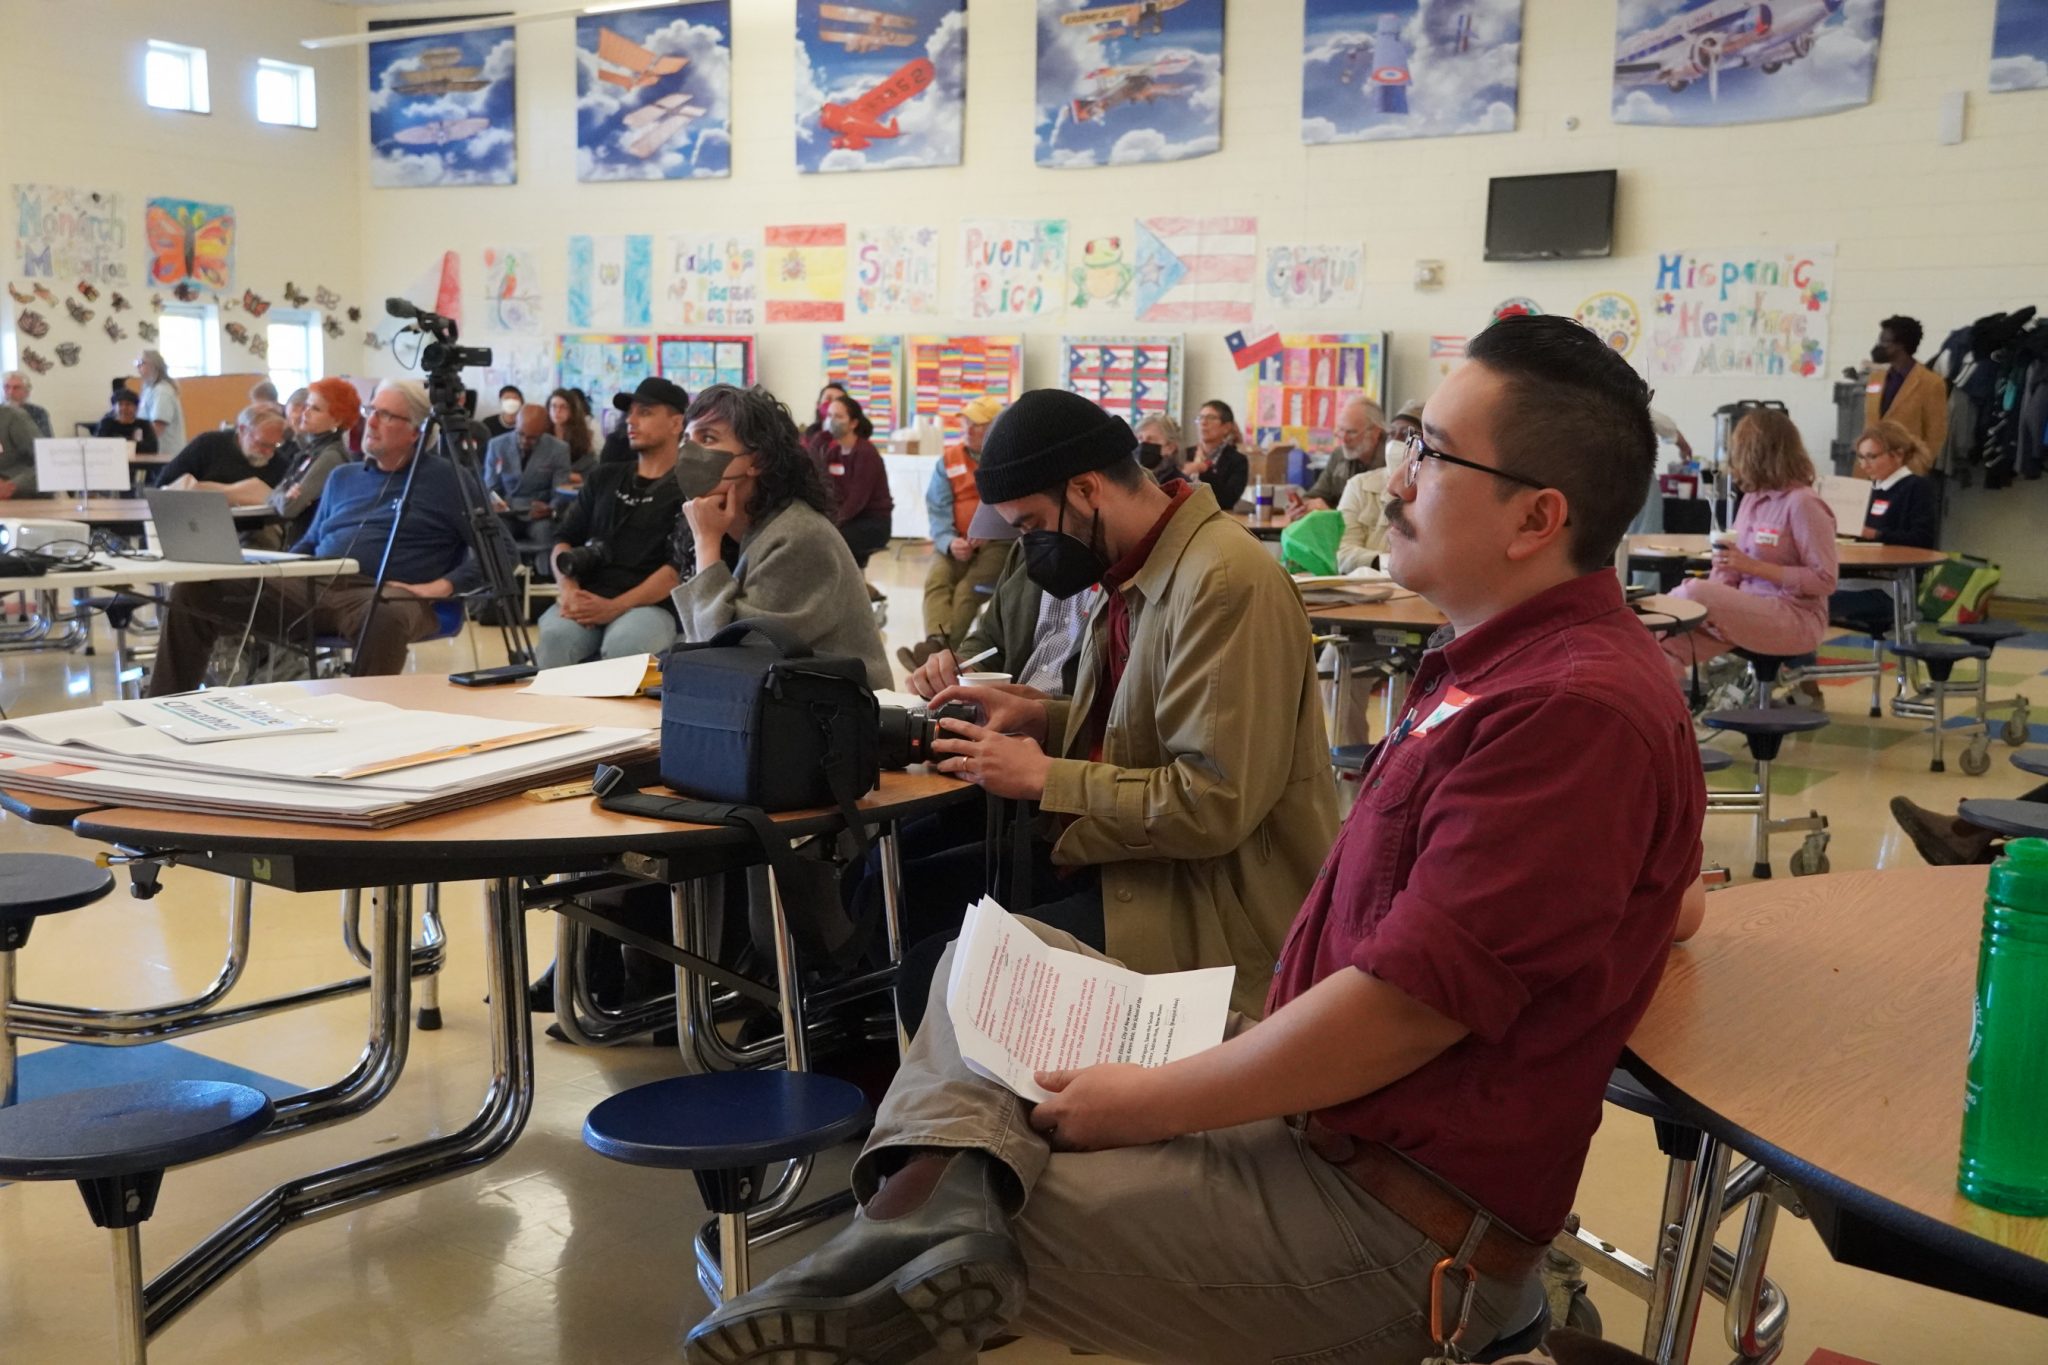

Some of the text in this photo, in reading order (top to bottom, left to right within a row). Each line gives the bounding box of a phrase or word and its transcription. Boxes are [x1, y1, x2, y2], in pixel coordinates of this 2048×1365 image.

[859, 245, 929, 289] Spain
[965, 226, 1062, 271] Puerto
[973, 273, 1043, 319] Rico
[1655, 254, 1814, 301] Hispanic
[163, 701, 241, 730] Climathon
[207, 697, 249, 710] New
